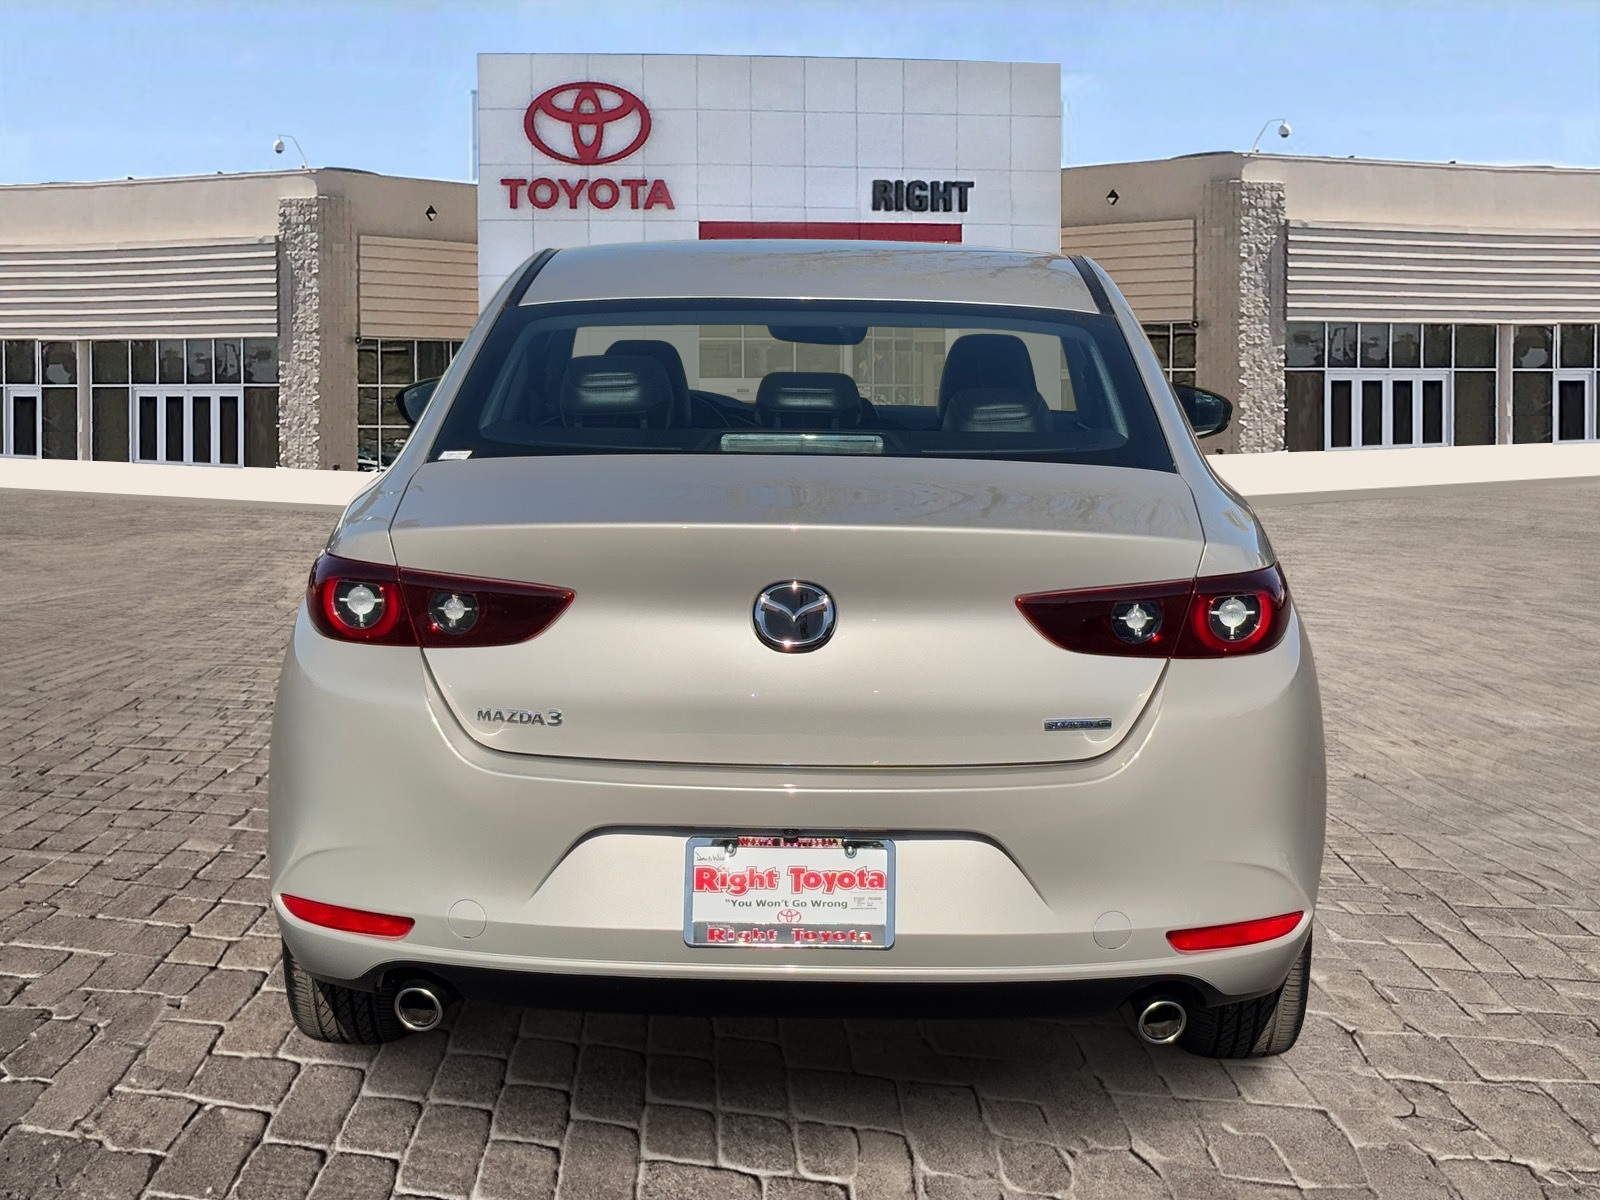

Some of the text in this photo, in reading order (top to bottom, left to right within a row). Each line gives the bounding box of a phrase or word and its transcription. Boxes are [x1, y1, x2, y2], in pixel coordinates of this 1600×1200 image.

[500, 177, 675, 210] TOYOTA
[870, 178, 975, 213] RIGHT
[693, 865, 887, 896] Right Toyota
[756, 899, 789, 908] Won't
[792, 899, 808, 908] Go
[811, 899, 848, 910] Wrong
[707, 928, 872, 944] Right Toyota
